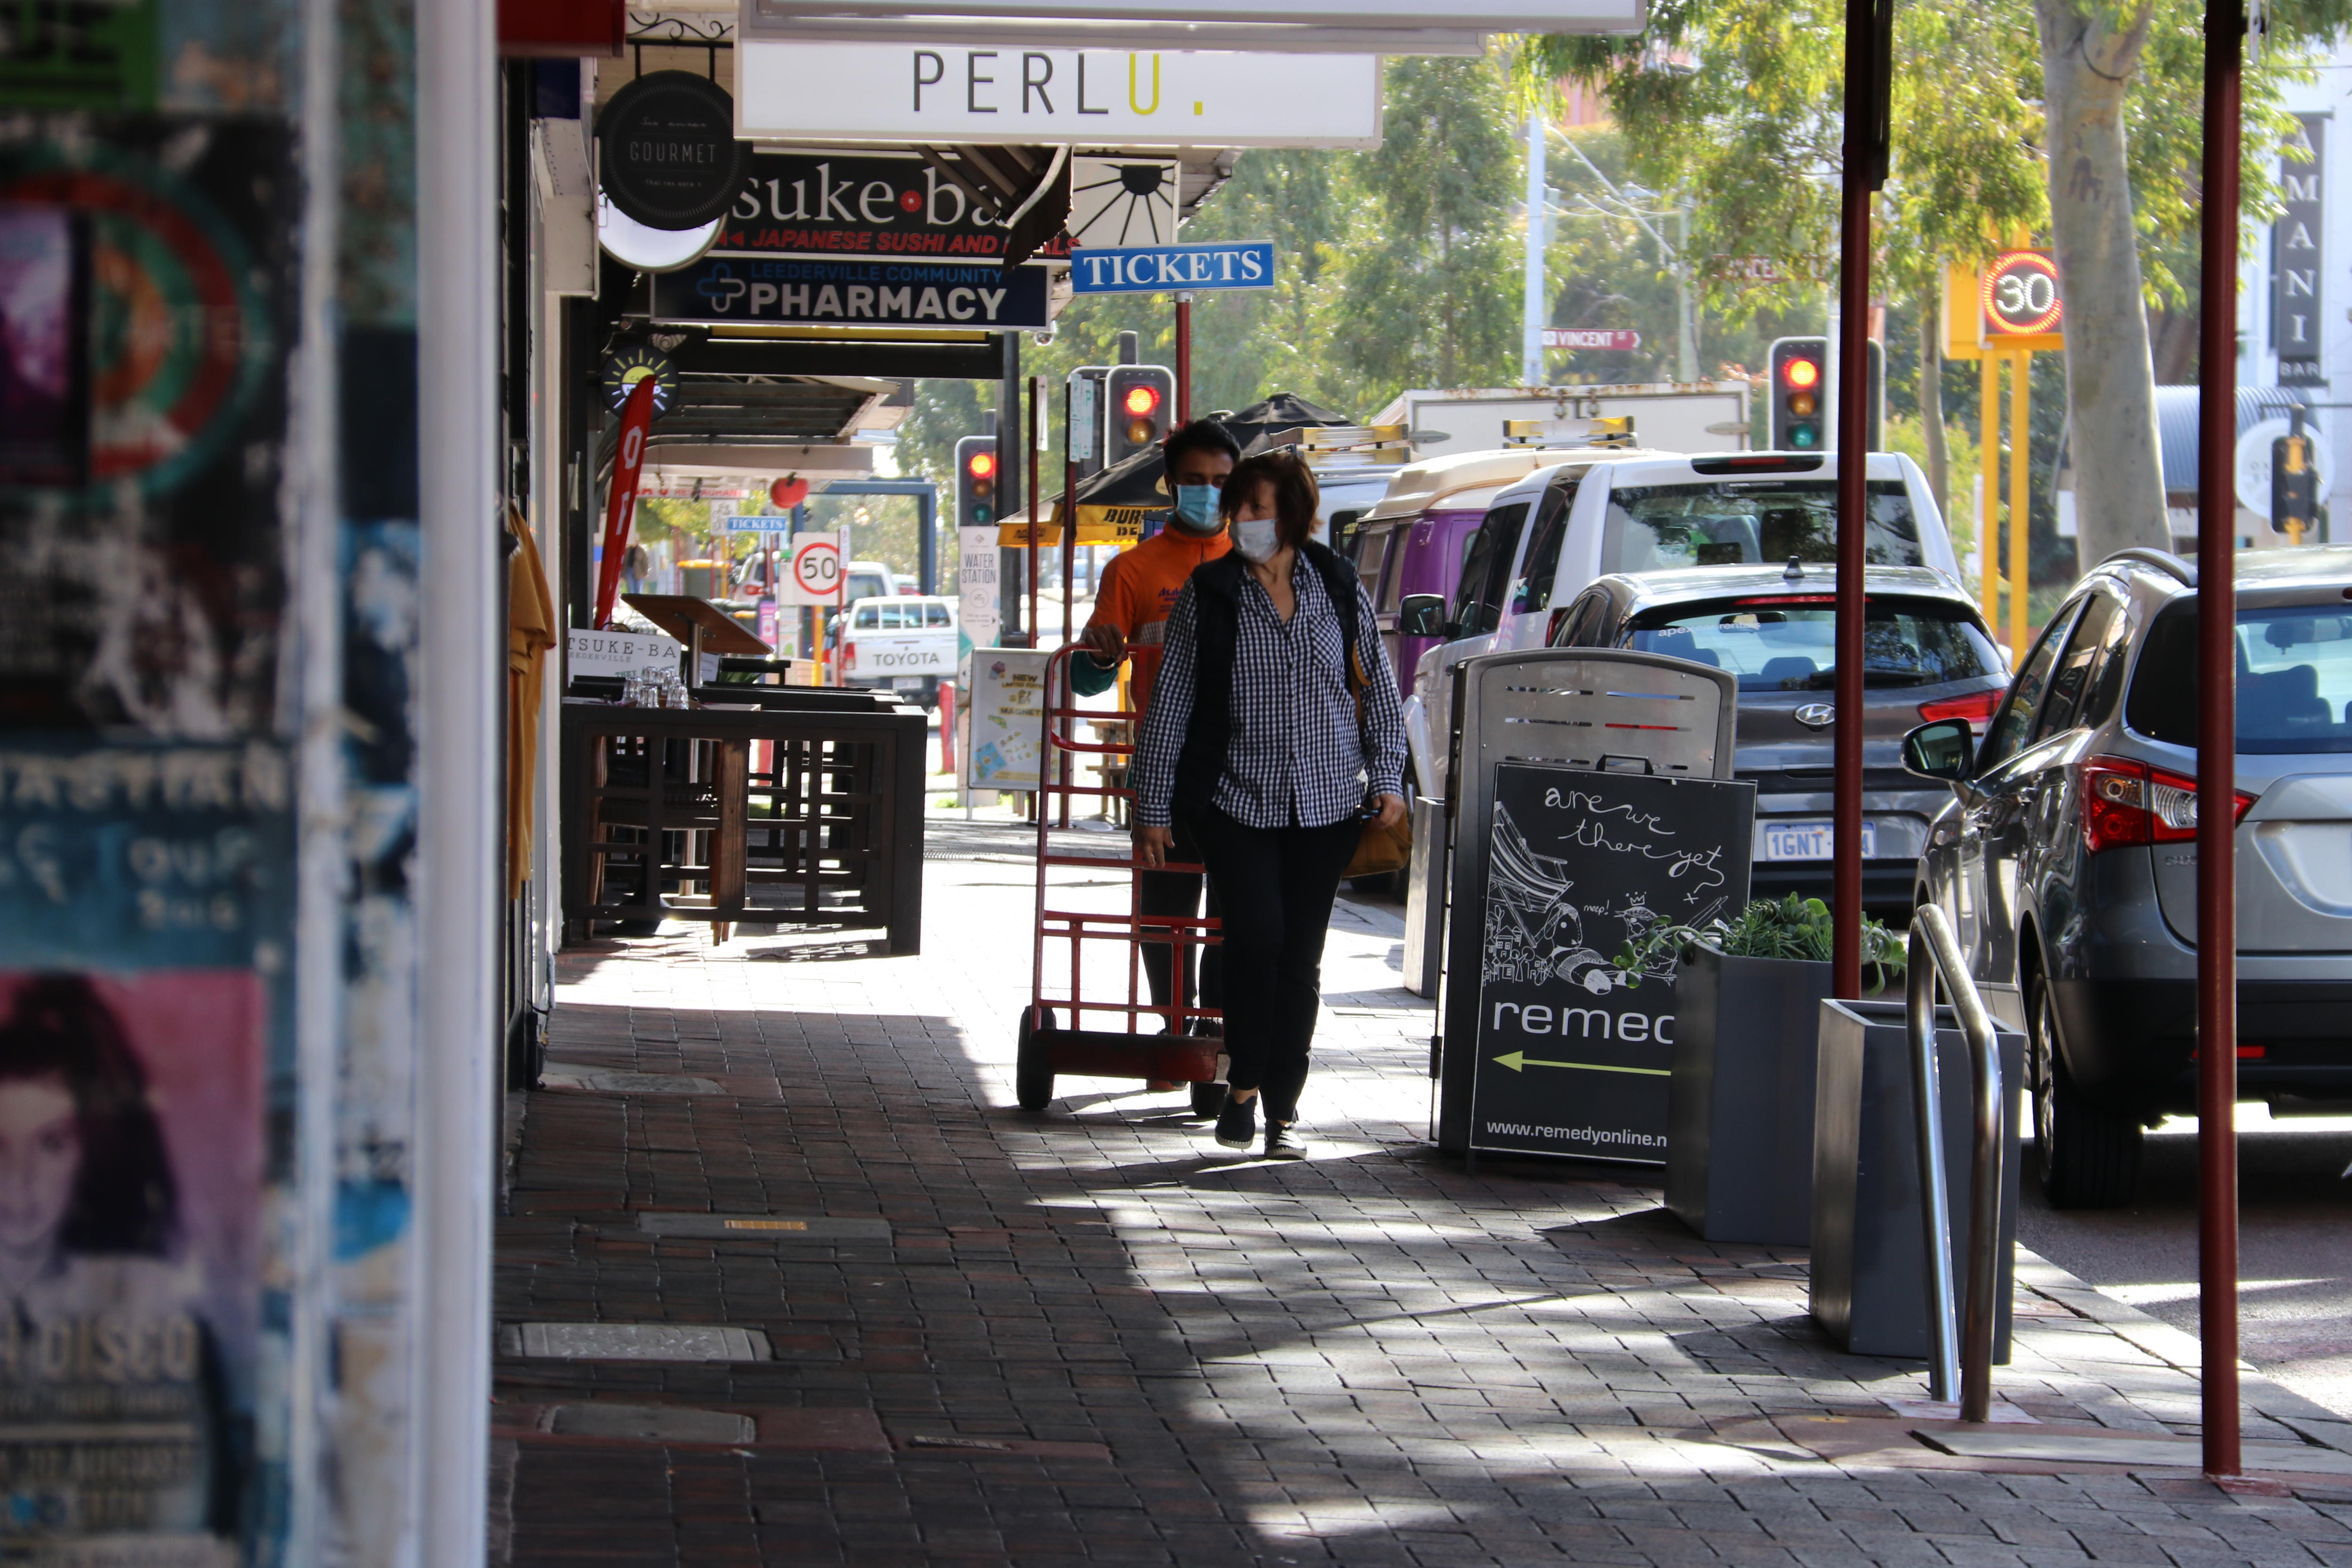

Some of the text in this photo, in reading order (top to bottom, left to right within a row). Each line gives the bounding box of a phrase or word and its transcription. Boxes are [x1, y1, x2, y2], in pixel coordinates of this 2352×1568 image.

[913, 50, 1203, 116] PERLU.
[629, 141, 716, 163] GOURMET
[752, 229, 872, 250] JAPANESE
[876, 232, 945, 253] SUSHI
[948, 235, 998, 254] AND
[751, 263, 1002, 283] LEEDERVILLE COMMUNITY
[1083, 250, 1263, 286] TICKETS
[751, 283, 1007, 320] PHARMACY
[1995, 272, 2055, 313] 30
[1558, 331, 1613, 347] VINCENT
[674, 488, 742, 497] RESAURANT
[729, 518, 783, 529] TICKETS
[803, 557, 836, 580] 50
[964, 553, 994, 568] WATER
[961, 569, 996, 584] STATION
[1657, 626, 1695, 637] apex
[1719, 621, 1761, 630] rentals
[873, 652, 940, 666] TOYOTA
[1012, 674, 1038, 683] NEW
[1000, 708, 1042, 716] MAGNET
[1545, 787, 1676, 835] are we
[1558, 818, 1723, 878] there yet
[1583, 899, 1610, 915] meep!
